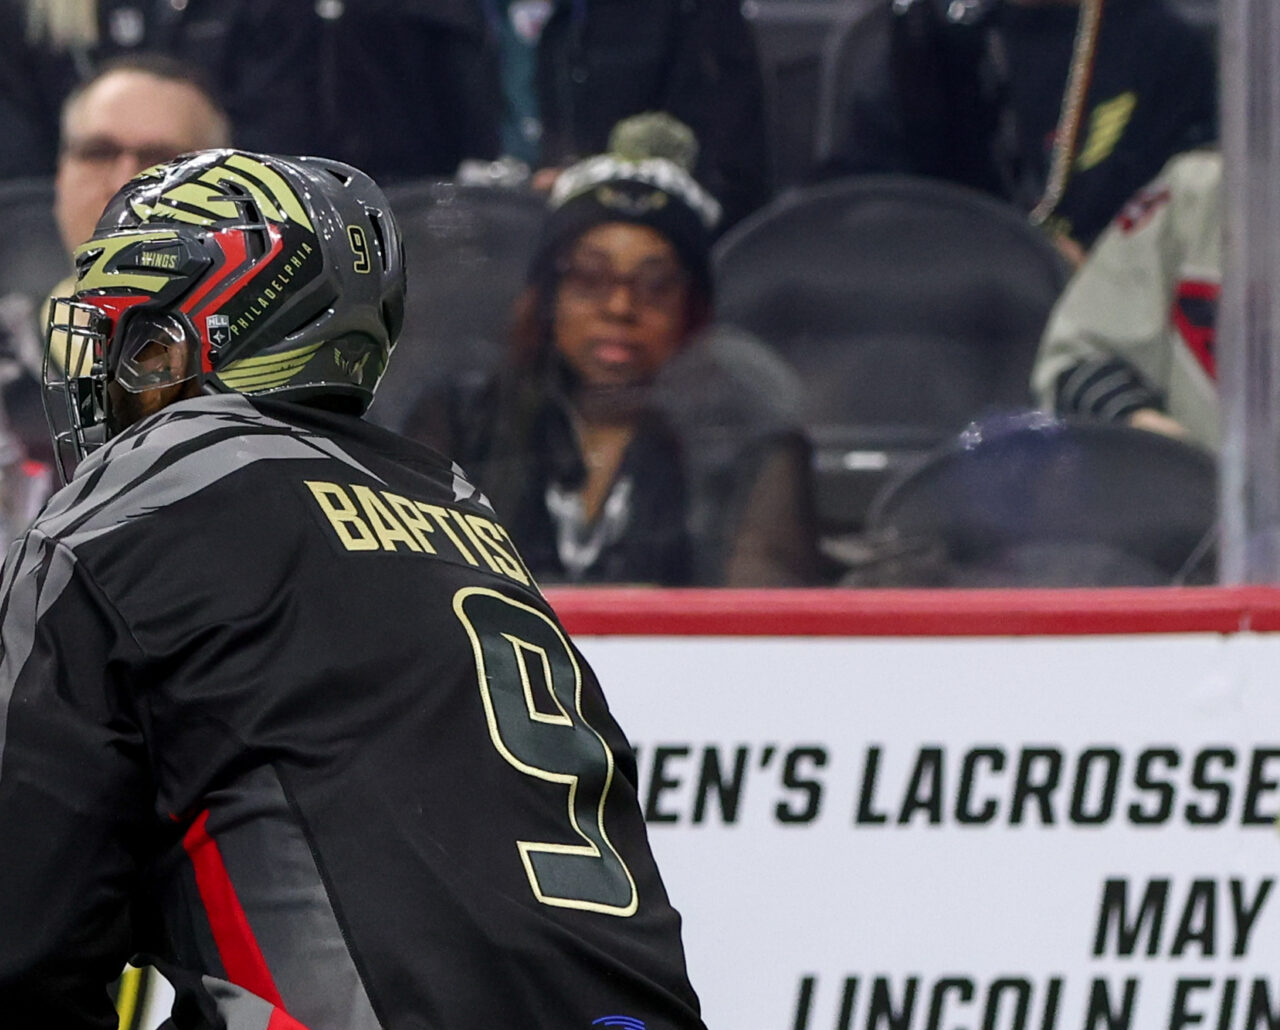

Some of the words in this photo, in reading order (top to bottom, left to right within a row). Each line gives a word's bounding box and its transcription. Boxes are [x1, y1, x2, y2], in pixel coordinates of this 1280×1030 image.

[141, 251, 178, 269] WINGS
[347, 224, 371, 274] 9
[230, 241, 313, 337] PHILADELPHIA
[452, 586, 638, 918] 9
[634, 747, 828, 824] EN'S
[855, 747, 1280, 825] LACROSSE
[1091, 878, 1275, 958] MAY
